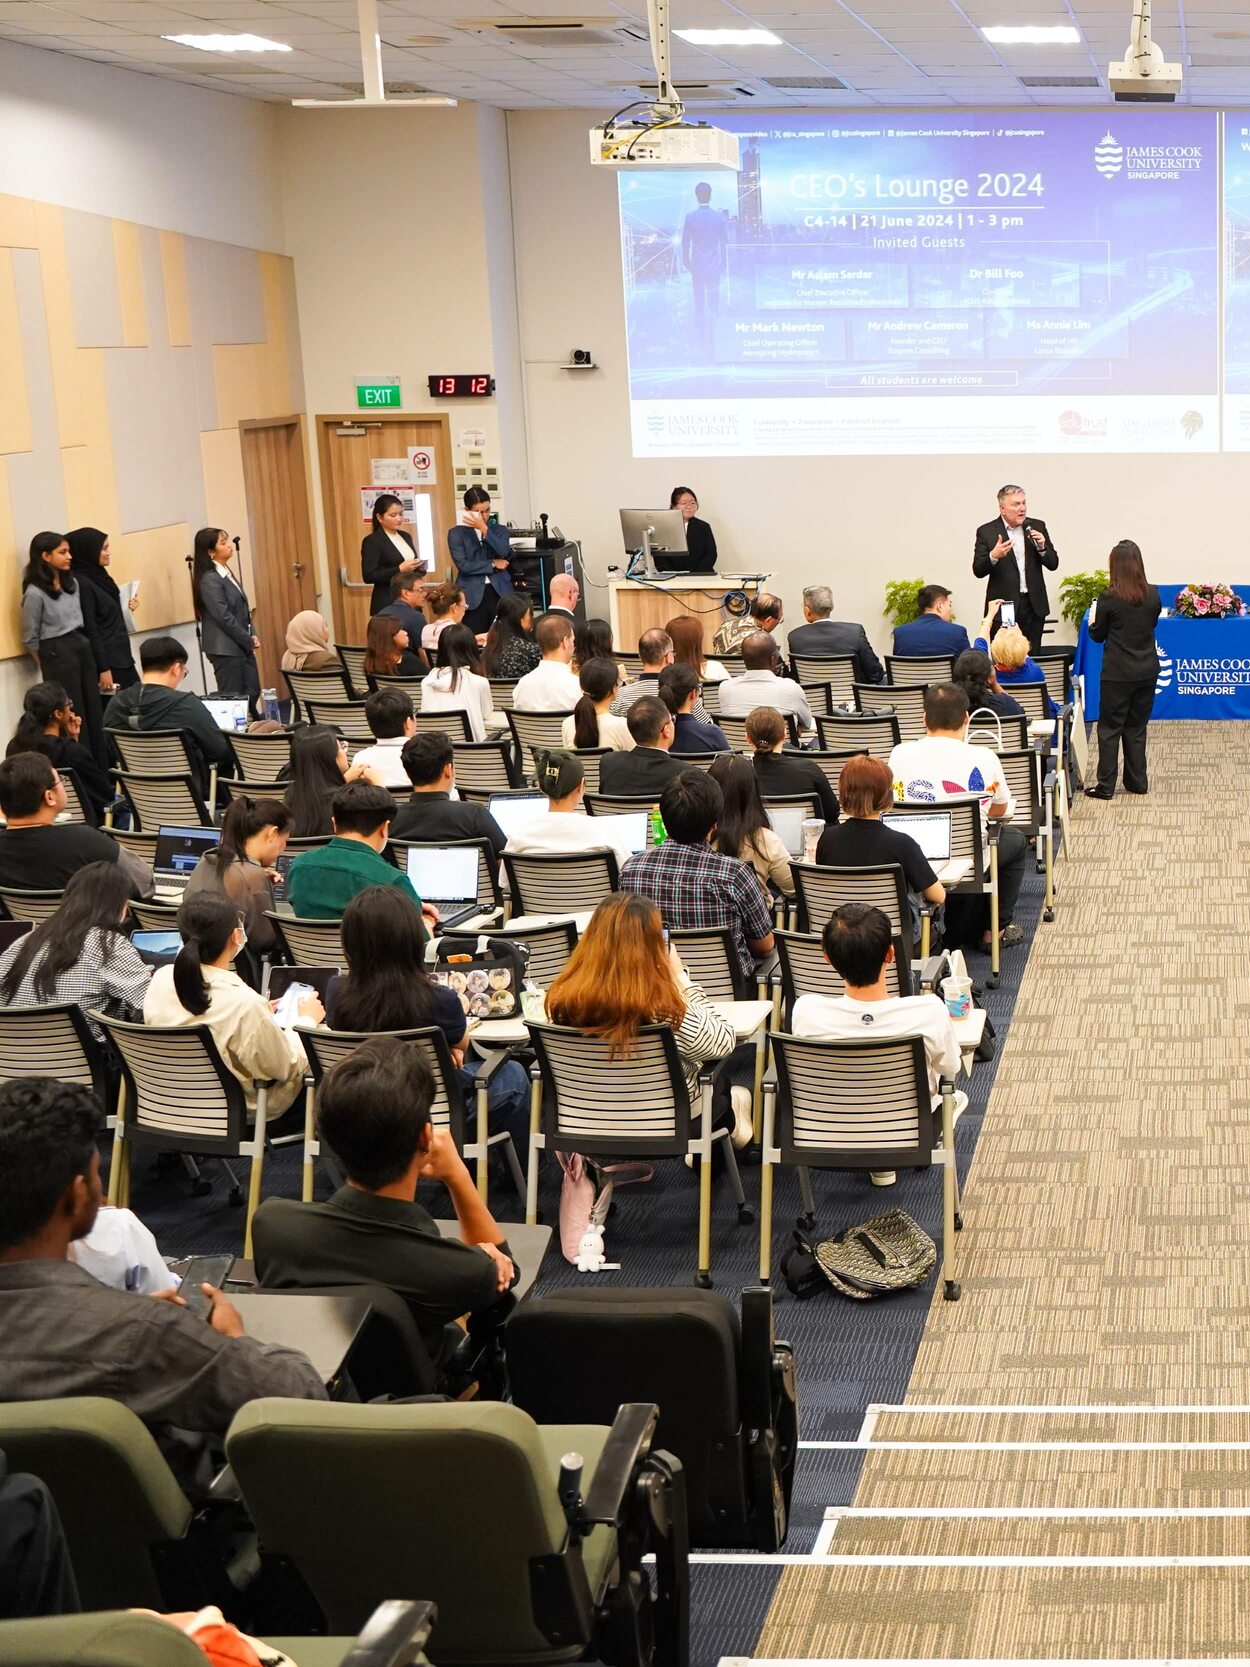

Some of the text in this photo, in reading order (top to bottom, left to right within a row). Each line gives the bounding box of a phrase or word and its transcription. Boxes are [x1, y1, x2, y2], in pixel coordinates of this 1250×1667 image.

[1126, 147, 1202, 157] JAMES COOK
[1126, 159, 1202, 169] UNIVERSITY
[1127, 172, 1179, 180] SINGAPORE
[789, 173, 1045, 204] CEO's Lounge 2024
[804, 215, 848, 227] C4-14
[861, 215, 877, 227] 21
[880, 215, 913, 229] June
[917, 215, 954, 226] 2024
[967, 214, 974, 226] 1
[989, 214, 997, 226] 3
[1002, 217, 1024, 229] pm
[873, 236, 966, 248] Invited Guests
[792, 270, 807, 279] Mr
[841, 270, 873, 279] Sardar
[970, 269, 1024, 278] Dr Bill Foo
[735, 323, 825, 332] Mr Mark Newton
[868, 322, 969, 330] Mr Andrew Cameron
[1026, 320, 1092, 329] Ms Annie Lim
[860, 375, 983, 385] All students are welcome
[439, 378, 487, 393] 13 12
[365, 389, 392, 404] EXIT
[668, 415, 739, 424] JAMES COOK
[668, 426, 739, 436] UNIVERSITY
[1176, 659, 1219, 671] JAMES
[1177, 686, 1236, 695] SINGAPORE
